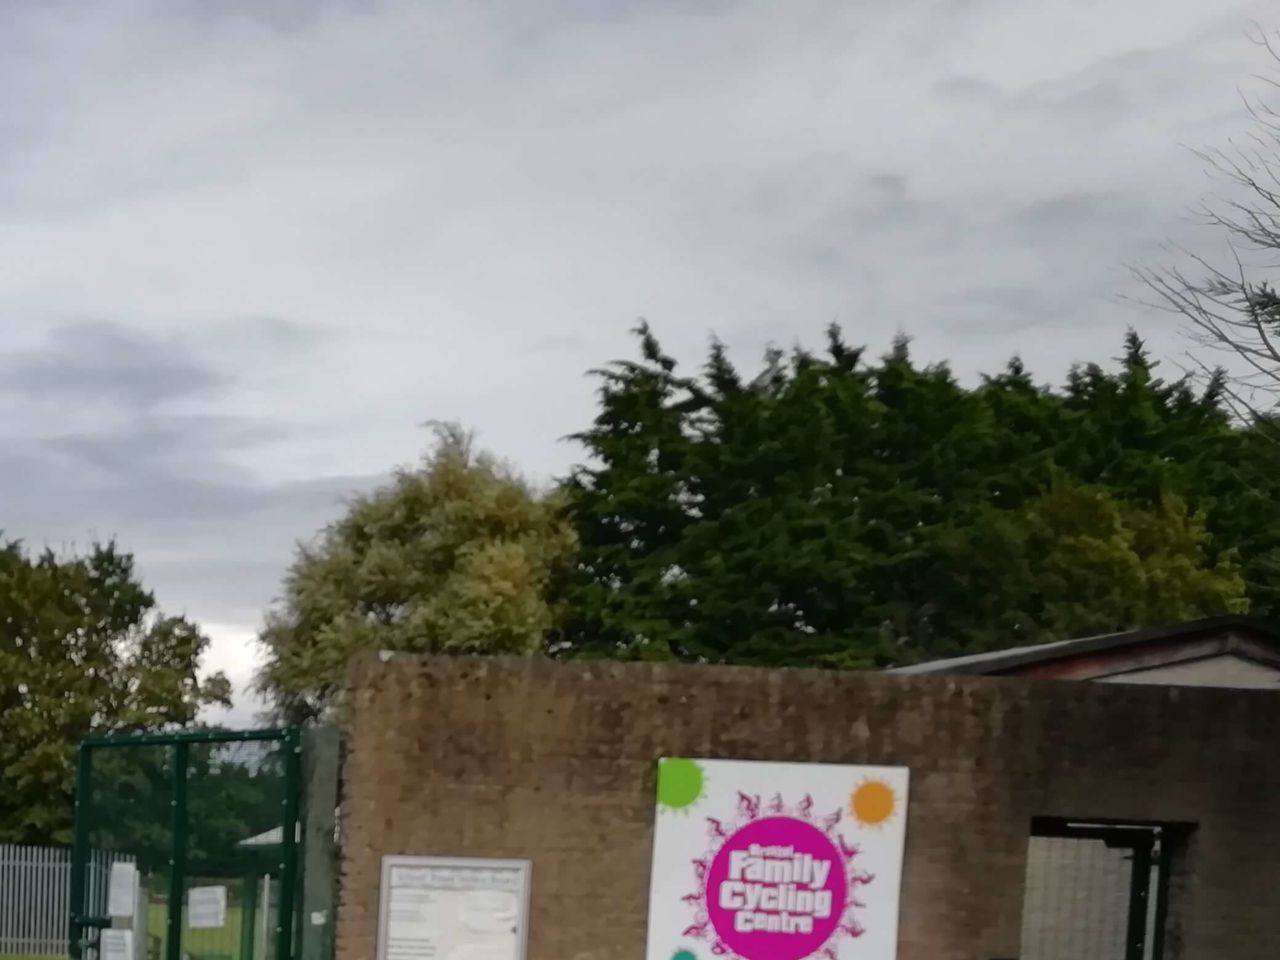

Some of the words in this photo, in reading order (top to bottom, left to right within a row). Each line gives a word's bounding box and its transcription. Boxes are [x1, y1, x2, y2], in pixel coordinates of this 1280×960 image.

[729, 850, 831, 889] Family
[719, 880, 832, 918] Cycling
[734, 910, 813, 934] Centre
